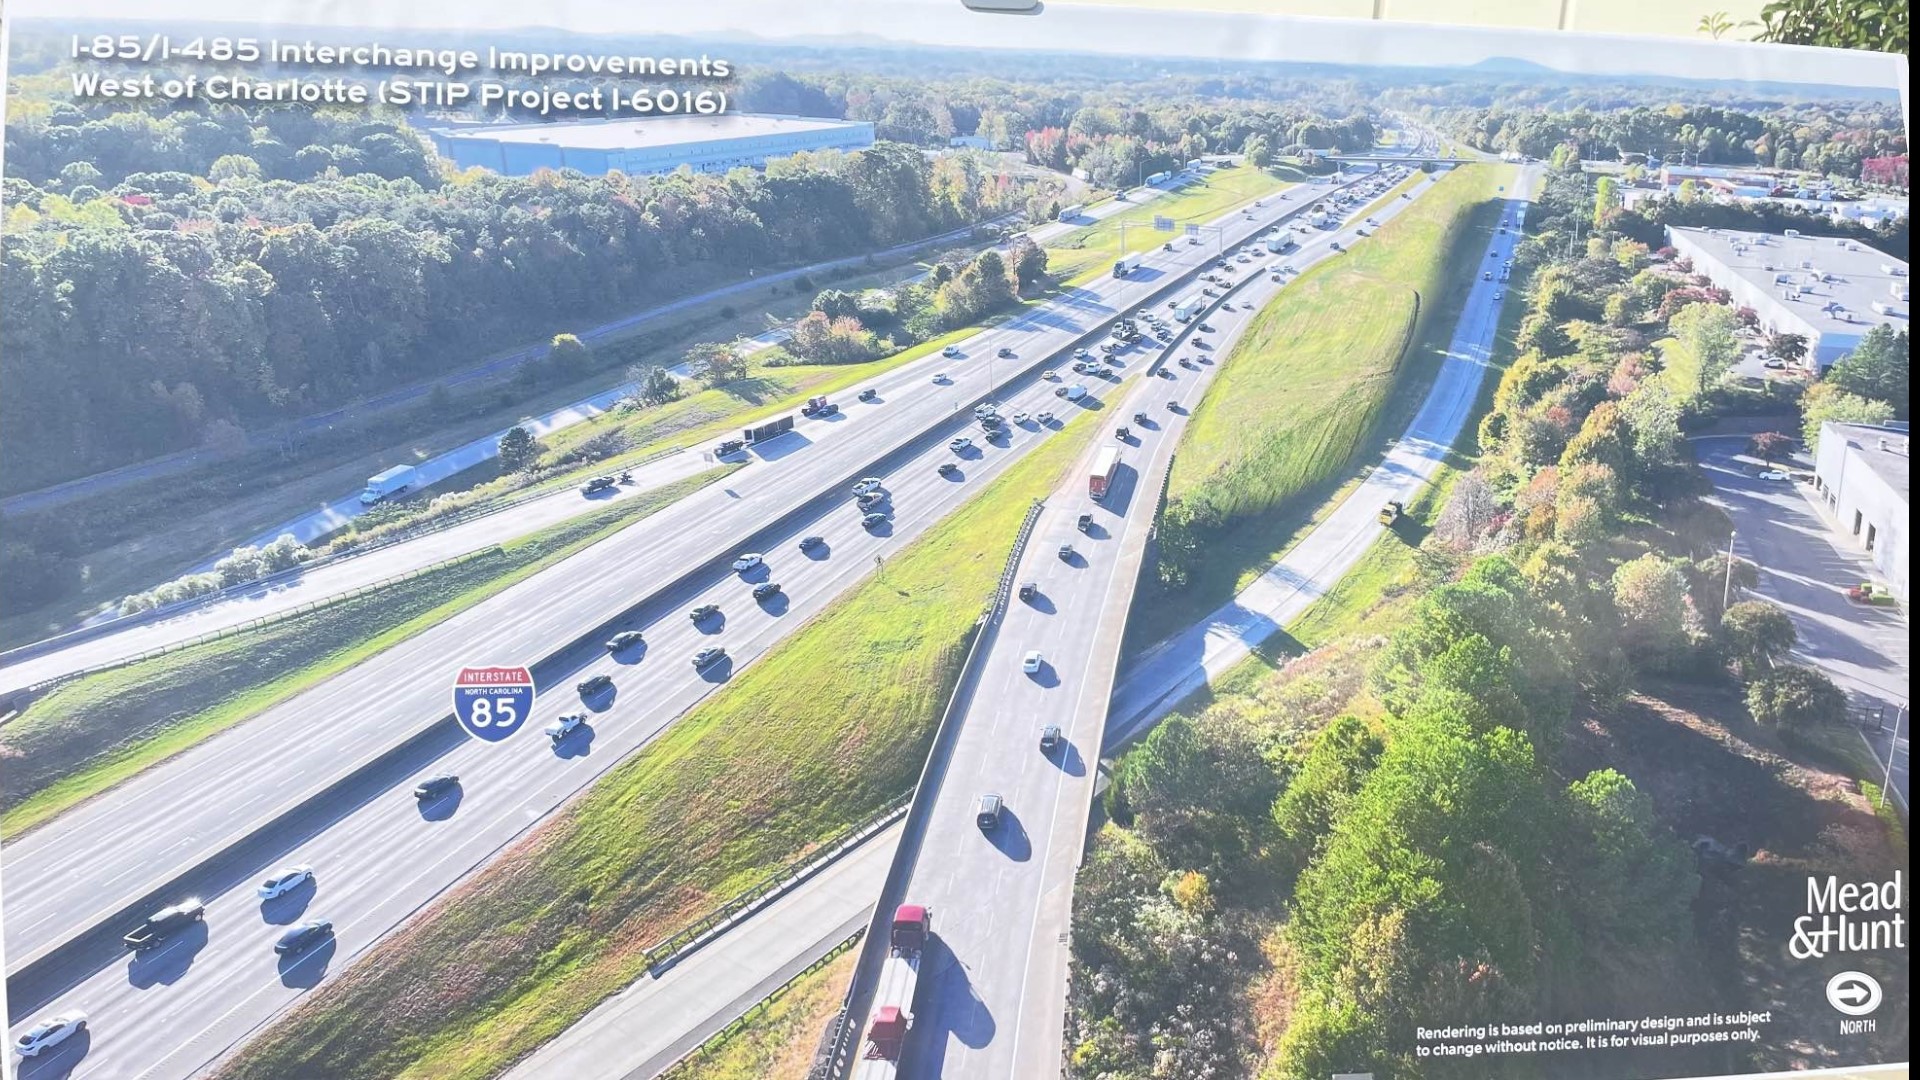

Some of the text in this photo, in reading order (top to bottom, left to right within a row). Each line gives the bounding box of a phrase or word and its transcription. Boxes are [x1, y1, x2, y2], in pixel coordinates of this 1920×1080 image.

[72, 33, 730, 77] I-85/I-485 Interchange Improvements
[71, 73, 727, 115] West of Charlotte (STIP Project I-6016)
[463, 671, 523, 683] INTERSTATE
[489, 687, 523, 695] CAROLINA
[471, 697, 516, 728] 85
[1807, 869, 1902, 914] Mead
[1416, 1010, 1772, 1040] Rendering is based on preliminary design and is subject
[1839, 1019, 1876, 1035] NORTH
[1416, 1027, 1761, 1058] to change without notice. It is for visual purposes only.
